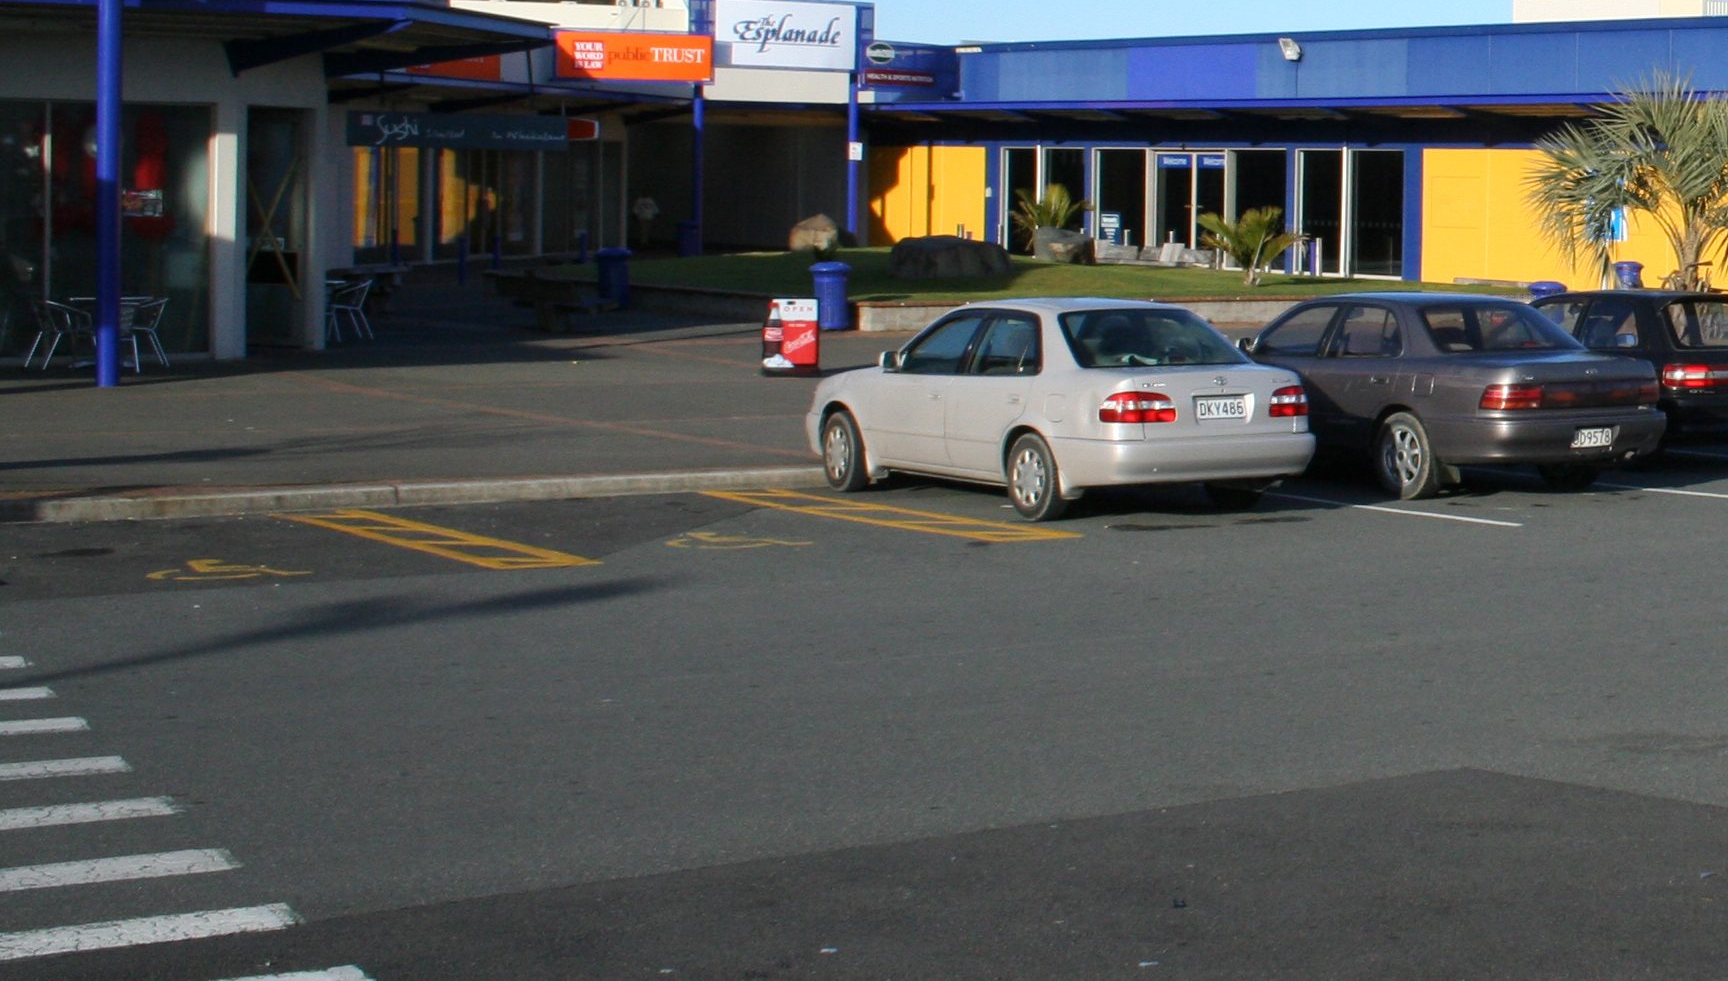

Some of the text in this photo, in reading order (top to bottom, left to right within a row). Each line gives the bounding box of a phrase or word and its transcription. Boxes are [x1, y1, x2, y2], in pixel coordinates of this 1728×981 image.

[732, 13, 841, 54] Esplanade
[574, 41, 604, 52] YOUR
[574, 51, 604, 61] WORD
[607, 46, 706, 66] public TRUST
[584, 60, 603, 70] LAW
[376, 114, 419, 145] Sushi
